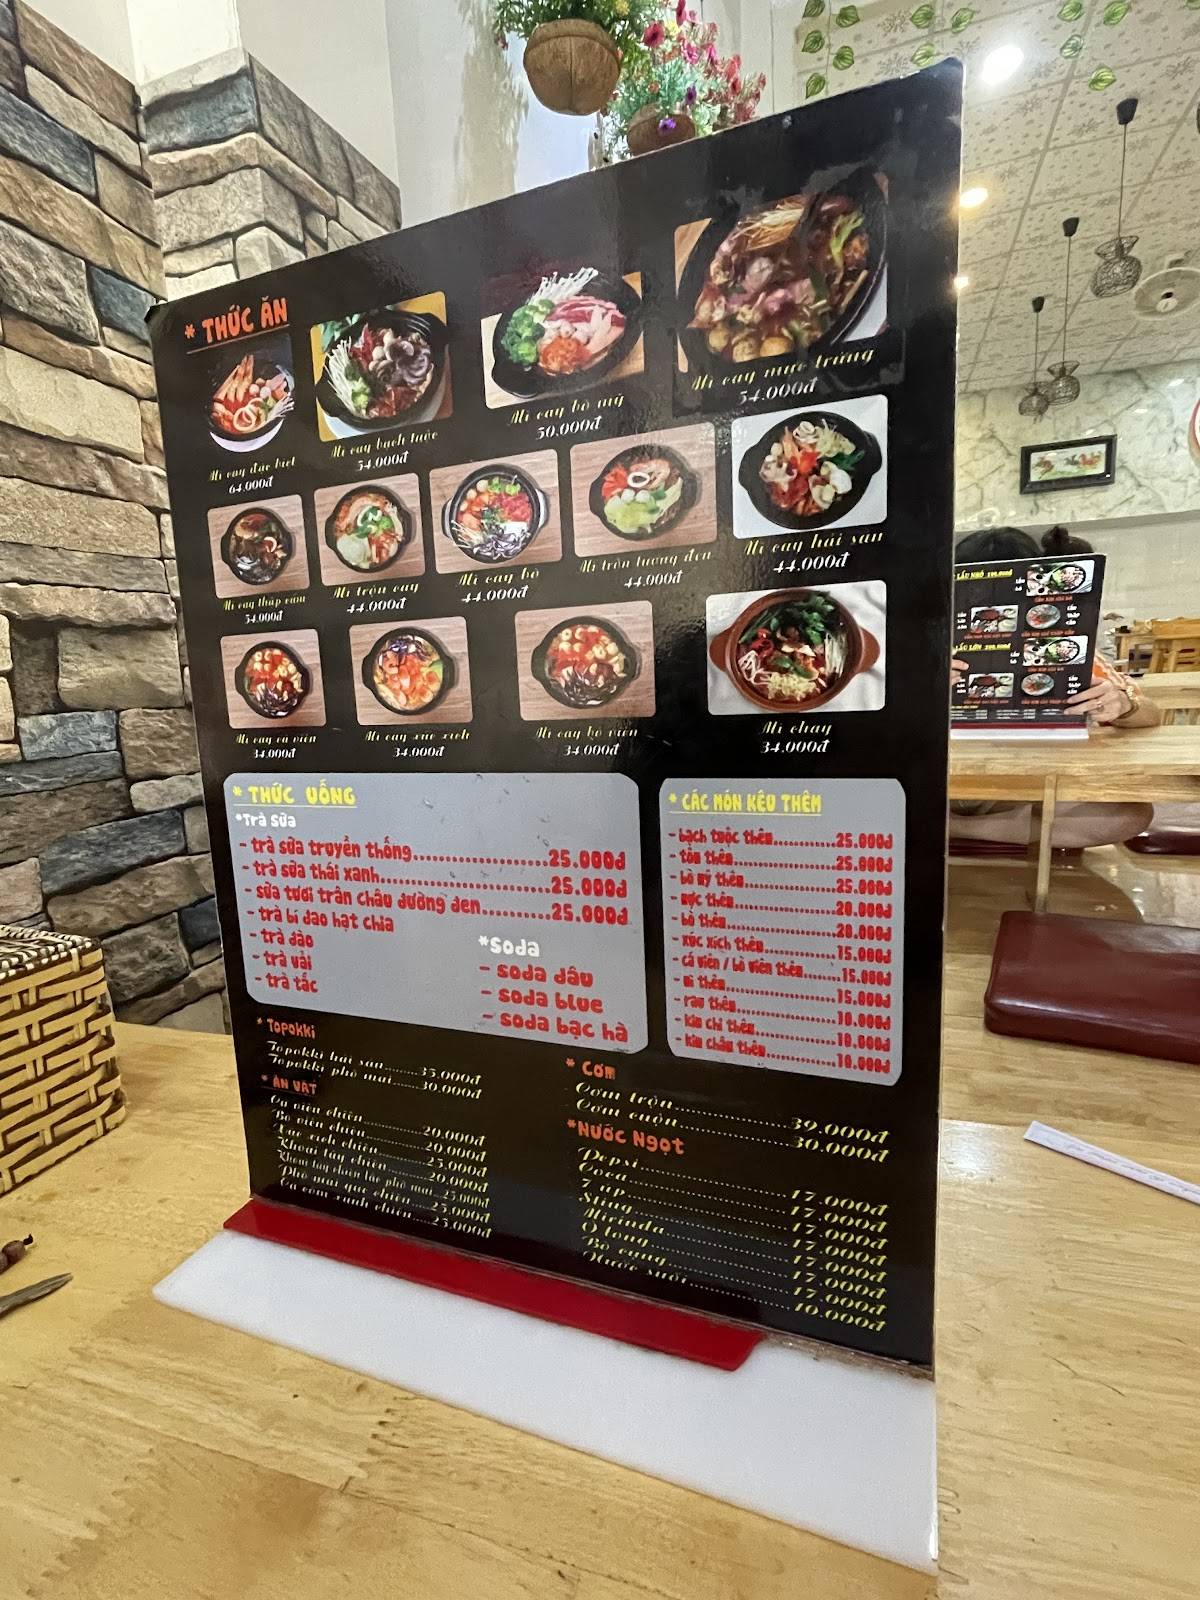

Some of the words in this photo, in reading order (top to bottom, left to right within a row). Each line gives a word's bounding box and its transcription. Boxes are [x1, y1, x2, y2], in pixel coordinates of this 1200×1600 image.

[202, 305, 254, 343] THỨC
[261, 296, 288, 328] ĂN
[721, 371, 756, 389] cay
[737, 377, 818, 405] 54.000đ
[535, 401, 565, 421] cay
[535, 416, 602, 440] 50.000đ
[350, 443, 371, 455] cay
[357, 451, 409, 471] 54.000đ
[226, 466, 246, 479] cay
[229, 475, 274, 494] 64.000đ
[772, 538, 802, 554] cay
[773, 552, 850, 573] 44.000đ
[392, 582, 420, 595] cay
[485, 572, 513, 584] cay
[624, 570, 684, 589] 44.000đ
[238, 598, 254, 610] cay
[461, 585, 529, 602] 44.000đ
[346, 597, 407, 614] 44.000đ
[385, 731, 406, 742] cay
[558, 727, 581, 739] cay
[790, 721, 832, 736] chay
[253, 735, 272, 745] cay
[563, 742, 620, 756] 34.000đ
[760, 740, 830, 754] 34.000đ
[253, 747, 296, 759] 34.000đ
[393, 746, 445, 757] 34.000đ
[248, 782, 295, 804] THỨC
[305, 779, 356, 805] UỐNG
[682, 789, 709, 811] CÁC
[714, 789, 742, 811] MÓN
[747, 789, 776, 812] KÊU
[781, 790, 821, 813] THÊM
[271, 813, 296, 828] sữa
[678, 828, 707, 848] bạch
[711, 826, 739, 847] tuộc
[836, 833, 893, 849] 25.000đ
[251, 836, 275, 854] trà
[279, 837, 304, 855] sữa
[308, 835, 360, 859] truyền
[365, 836, 412, 862] thống
[549, 849, 626, 870] 25.000đ
[836, 856, 893, 873] 25.000đ
[253, 859, 277, 876] trà
[281, 860, 305, 879] sữa
[310, 862, 339, 881] thái
[344, 866, 379, 883] xanh
[551, 876, 627, 898] 25.000đ
[680, 868, 695, 885] bò
[836, 879, 893, 896] 25.000đ
[257, 882, 280, 900] sữa
[284, 885, 313, 902] tươi
[318, 886, 352, 905] trân
[357, 889, 392, 908] châu
[398, 892, 445, 914] đường
[451, 899, 480, 914] đen
[551, 903, 628, 925] 25.000đ
[836, 901, 892, 919] 20.000đ
[259, 905, 282, 922] trà
[287, 908, 299, 924] bí
[303, 910, 328, 926] đao
[333, 912, 358, 932] hạt
[363, 915, 394, 932] chia
[681, 910, 695, 927] bò
[836, 923, 892, 942] 20.000đ
[261, 928, 284, 945] trà
[289, 930, 314, 948] đào
[264, 950, 287, 967] trà
[291, 951, 312, 970] vải
[706, 935, 731, 950] xích
[837, 945, 891, 964] 15.000đ
[497, 964, 546, 982] soda
[554, 966, 593, 987] dâu
[682, 952, 694, 967] cá
[697, 956, 719, 970] viên
[732, 956, 745, 972] bò
[842, 968, 891, 986] 15.000đ
[266, 972, 289, 989] trà
[293, 972, 318, 992] tắc
[499, 989, 548, 1007] soda
[555, 992, 603, 1013] blue
[837, 989, 891, 1009] 15.000đ
[500, 1013, 549, 1032] soda
[556, 1017, 595, 1039] bạc
[602, 1022, 628, 1042] hà
[837, 1011, 891, 1030] 10.000đ
[837, 1032, 890, 1052] 10.000đ
[267, 1041, 323, 1059] Topokki
[421, 1067, 482, 1085] 35.000đ
[582, 1060, 616, 1080] Cơm
[837, 1054, 890, 1073] 10.000đ
[268, 1053, 324, 1072] Topokki
[363, 1073, 392, 1085] mai
[422, 1082, 482, 1099] 30.000đ
[576, 1082, 621, 1101] Cơm
[629, 1092, 673, 1110] trộn
[790, 1117, 891, 1144] 39.000đ
[423, 1126, 485, 1147] 20.000đ
[576, 1098, 621, 1117] Cơm
[629, 1111, 678, 1128] cuộn
[791, 1136, 890, 1163] 30.000đ
[425, 1142, 486, 1163] 20.000đ
[633, 1129, 684, 1156] Ngọt
[428, 1172, 489, 1193] 20.000đ
[578, 1147, 639, 1168] Pepsi
[792, 1190, 888, 1216] 17.000đ
[579, 1162, 627, 1181] Coca
[790, 1206, 887, 1232] 17.000đ
[582, 1178, 592, 1188] 7
[600, 1185, 625, 1197] up
[792, 1223, 888, 1249] 17.000đ
[579, 1192, 632, 1214] Sting
[793, 1239, 887, 1266] 17.000đ
[583, 1207, 664, 1234] Mirinda
[794, 1255, 887, 1283] 17.000đ
[604, 1226, 648, 1247] long
[793, 1271, 887, 1299] 17.000đ
[794, 1287, 886, 1315] 17.000đ
[795, 1303, 886, 1331] 10.000đ
